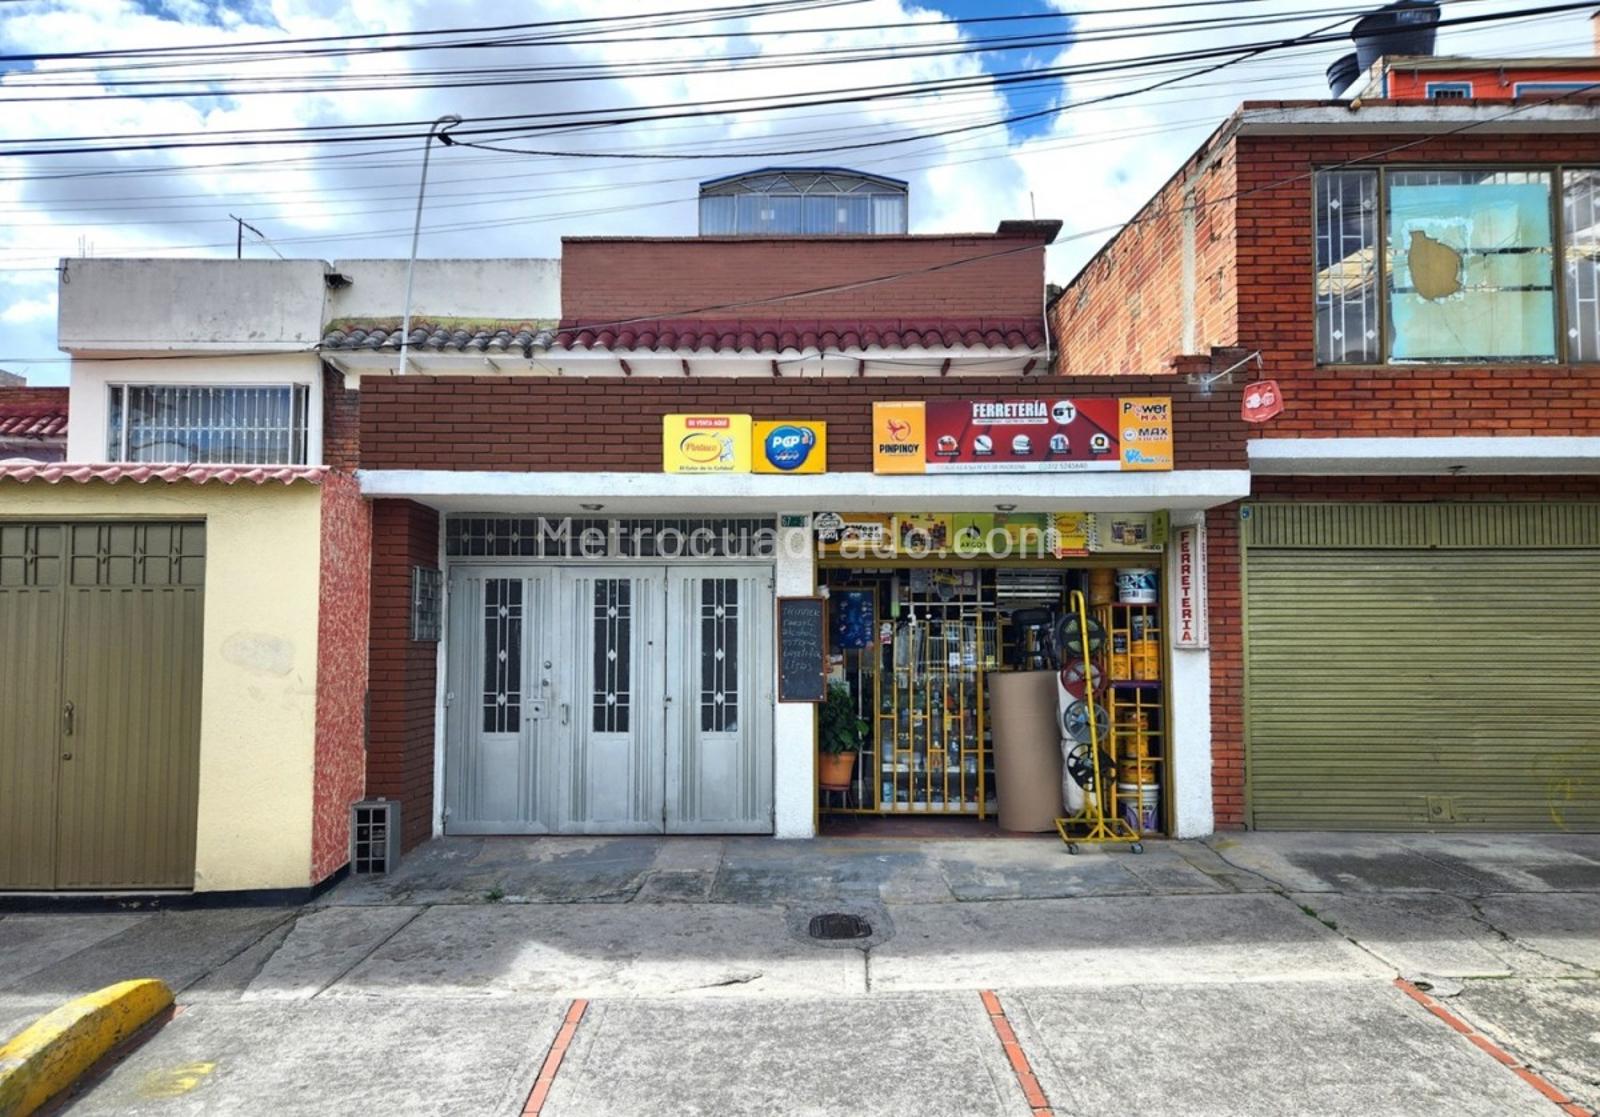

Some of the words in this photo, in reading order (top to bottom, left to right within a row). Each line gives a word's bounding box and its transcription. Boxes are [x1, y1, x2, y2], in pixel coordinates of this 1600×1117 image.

[973, 400, 1048, 418] FERRETERÍA
[1053, 407, 1074, 419] GT
[1124, 402, 1168, 414] Power
[1138, 428, 1167, 437] MAX
[879, 444, 920, 453] PINPINOY
[1180, 531, 1192, 641] FERRETERIA
